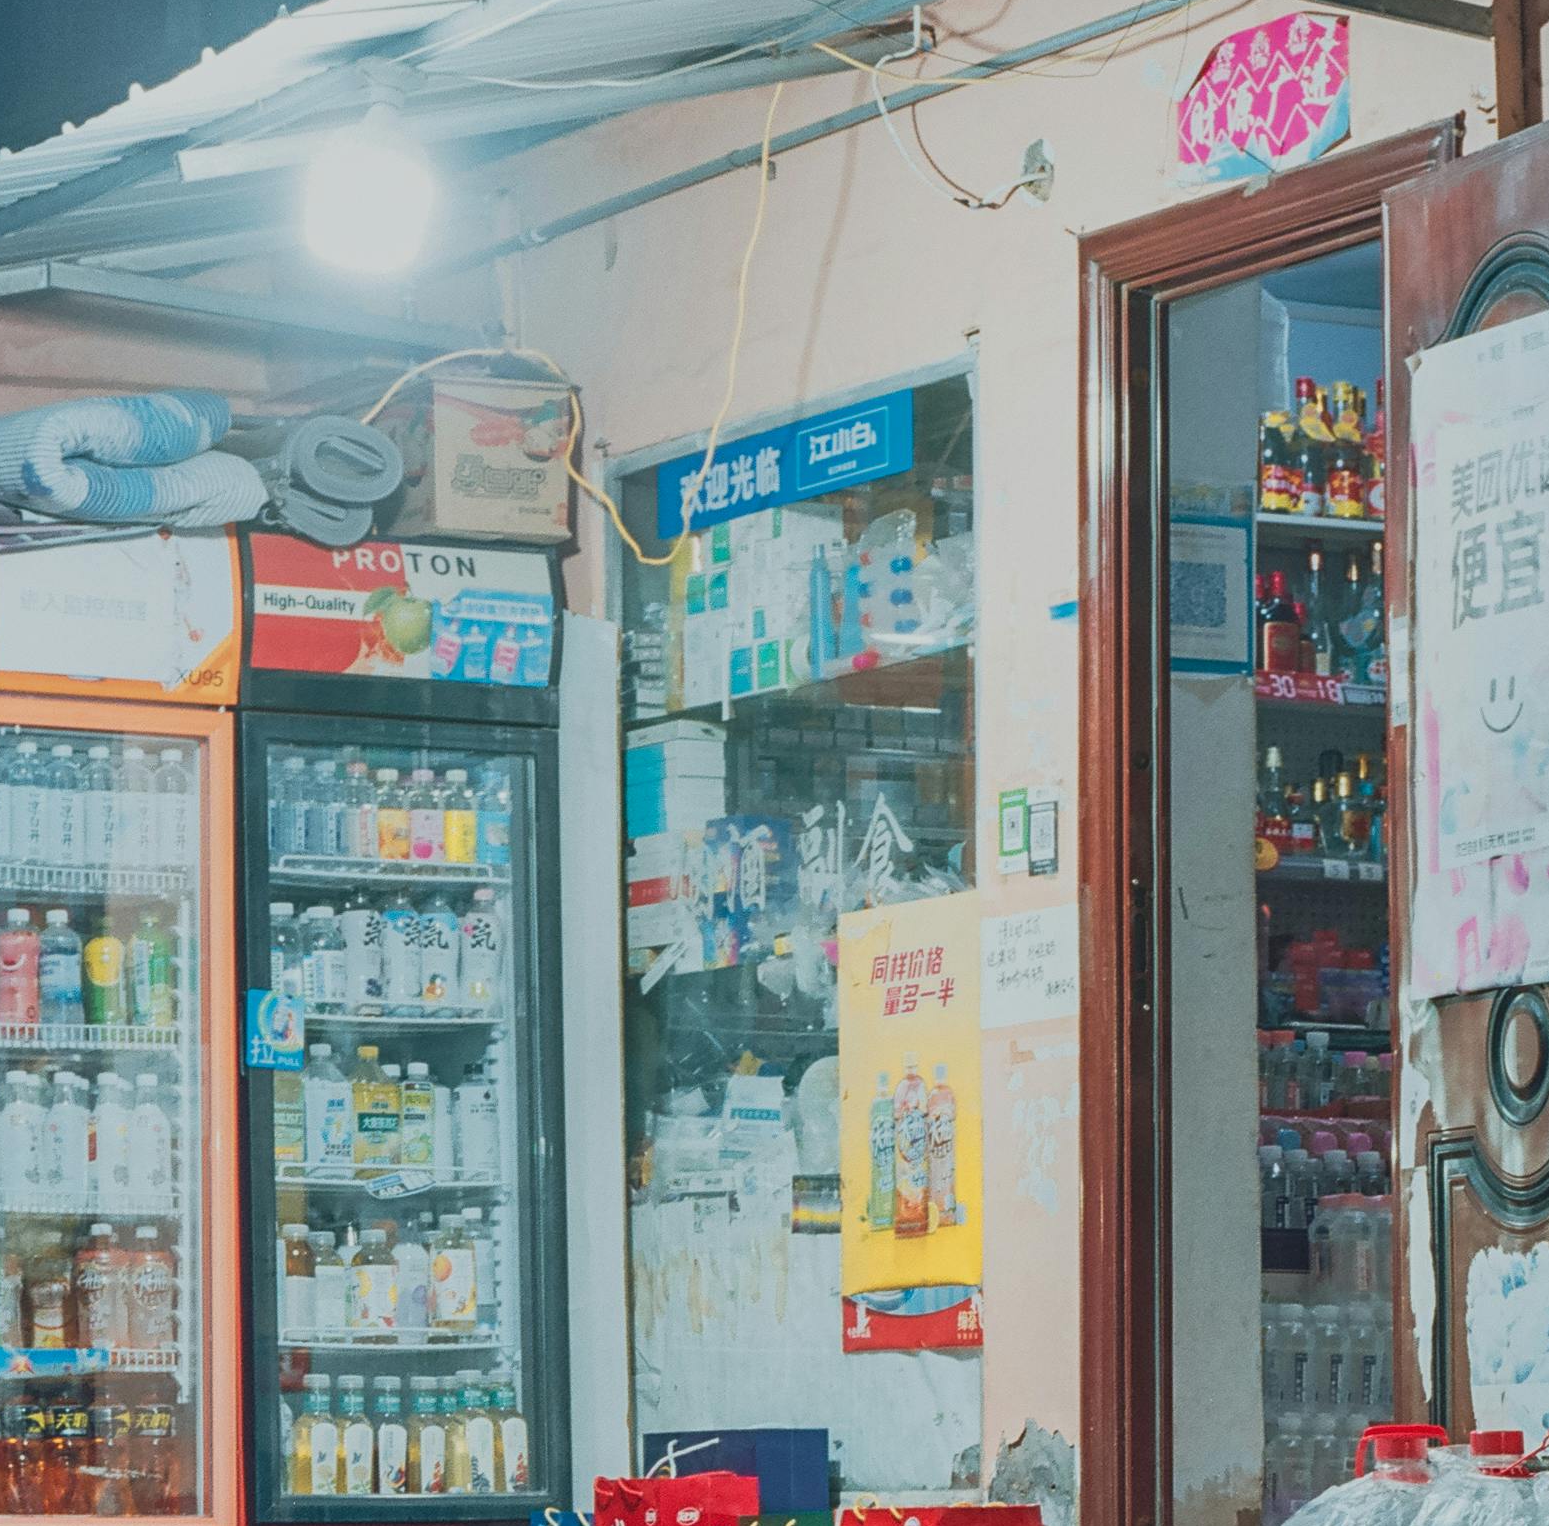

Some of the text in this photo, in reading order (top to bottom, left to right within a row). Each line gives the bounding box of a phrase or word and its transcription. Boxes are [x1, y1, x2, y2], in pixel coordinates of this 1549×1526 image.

[680, 421, 877, 516] 欢迎光临 江小白
[331, 547, 477, 579] PROTON
[1451, 508, 1546, 631] 便宜
[263, 592, 356, 615] High-Quality
[1269, 674, 1296, 698] 30
[870, 945, 944, 985] 同样价格
[882, 977, 955, 1017] 量多一半
